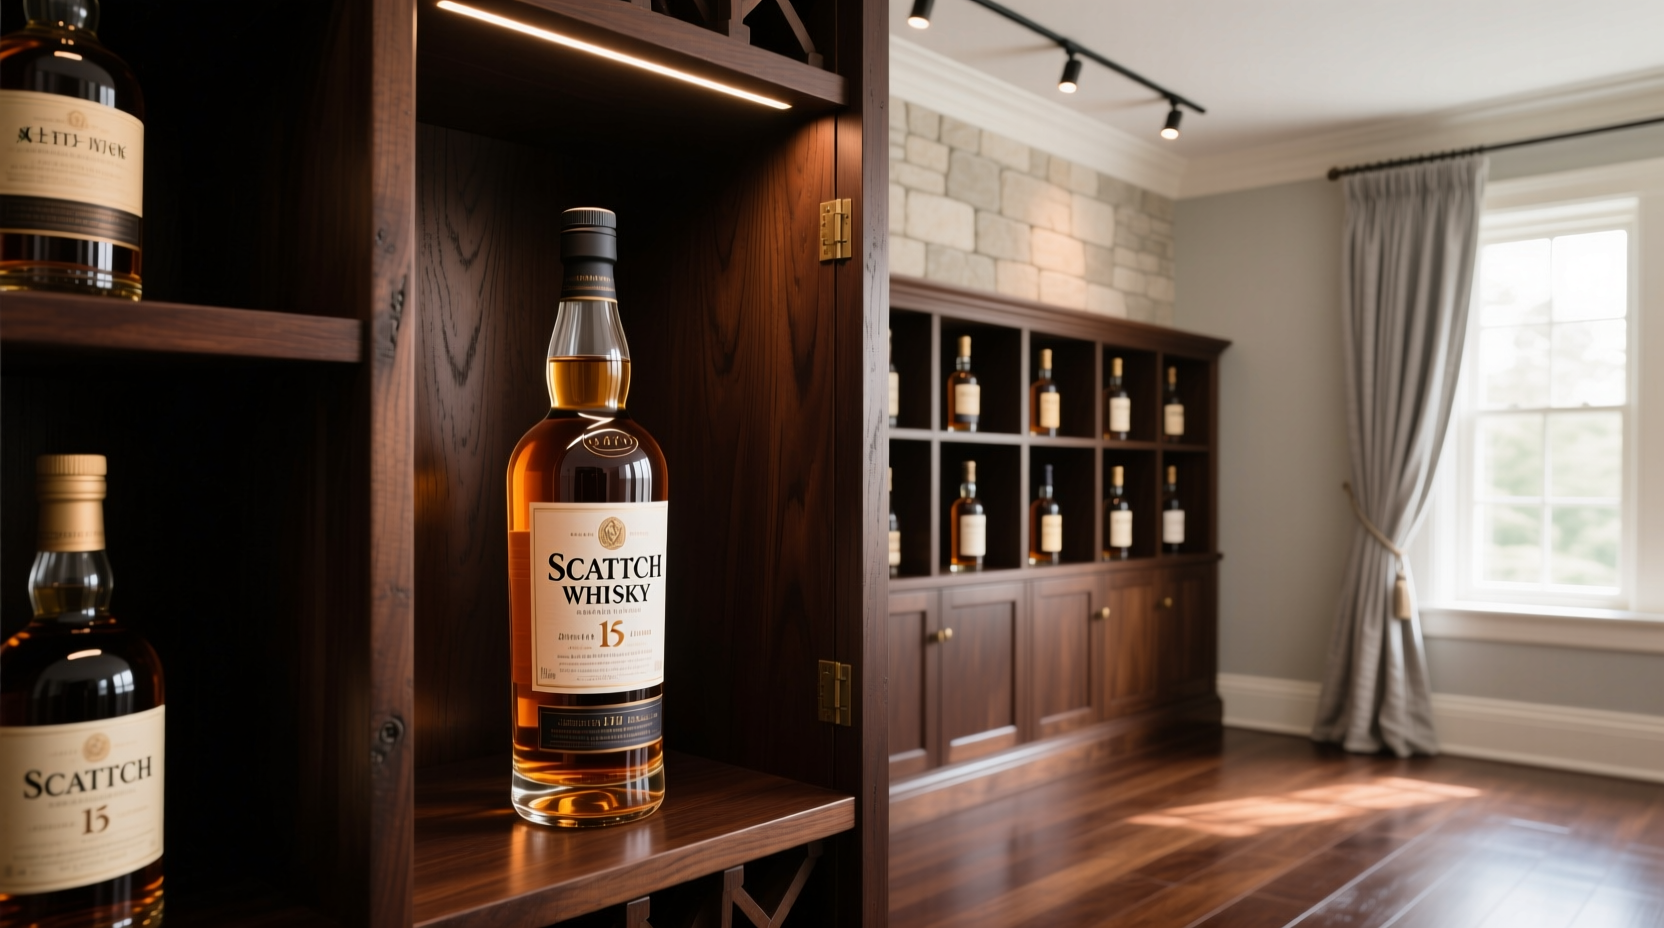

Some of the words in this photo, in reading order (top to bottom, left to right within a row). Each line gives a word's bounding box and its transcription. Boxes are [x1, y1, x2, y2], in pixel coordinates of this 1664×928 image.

[548, 552, 662, 582] SCATTCH
[561, 583, 651, 605] WHISKY
[598, 619, 625, 648] 15
[23, 755, 153, 800] SCATTCH
[81, 804, 110, 836] 15
